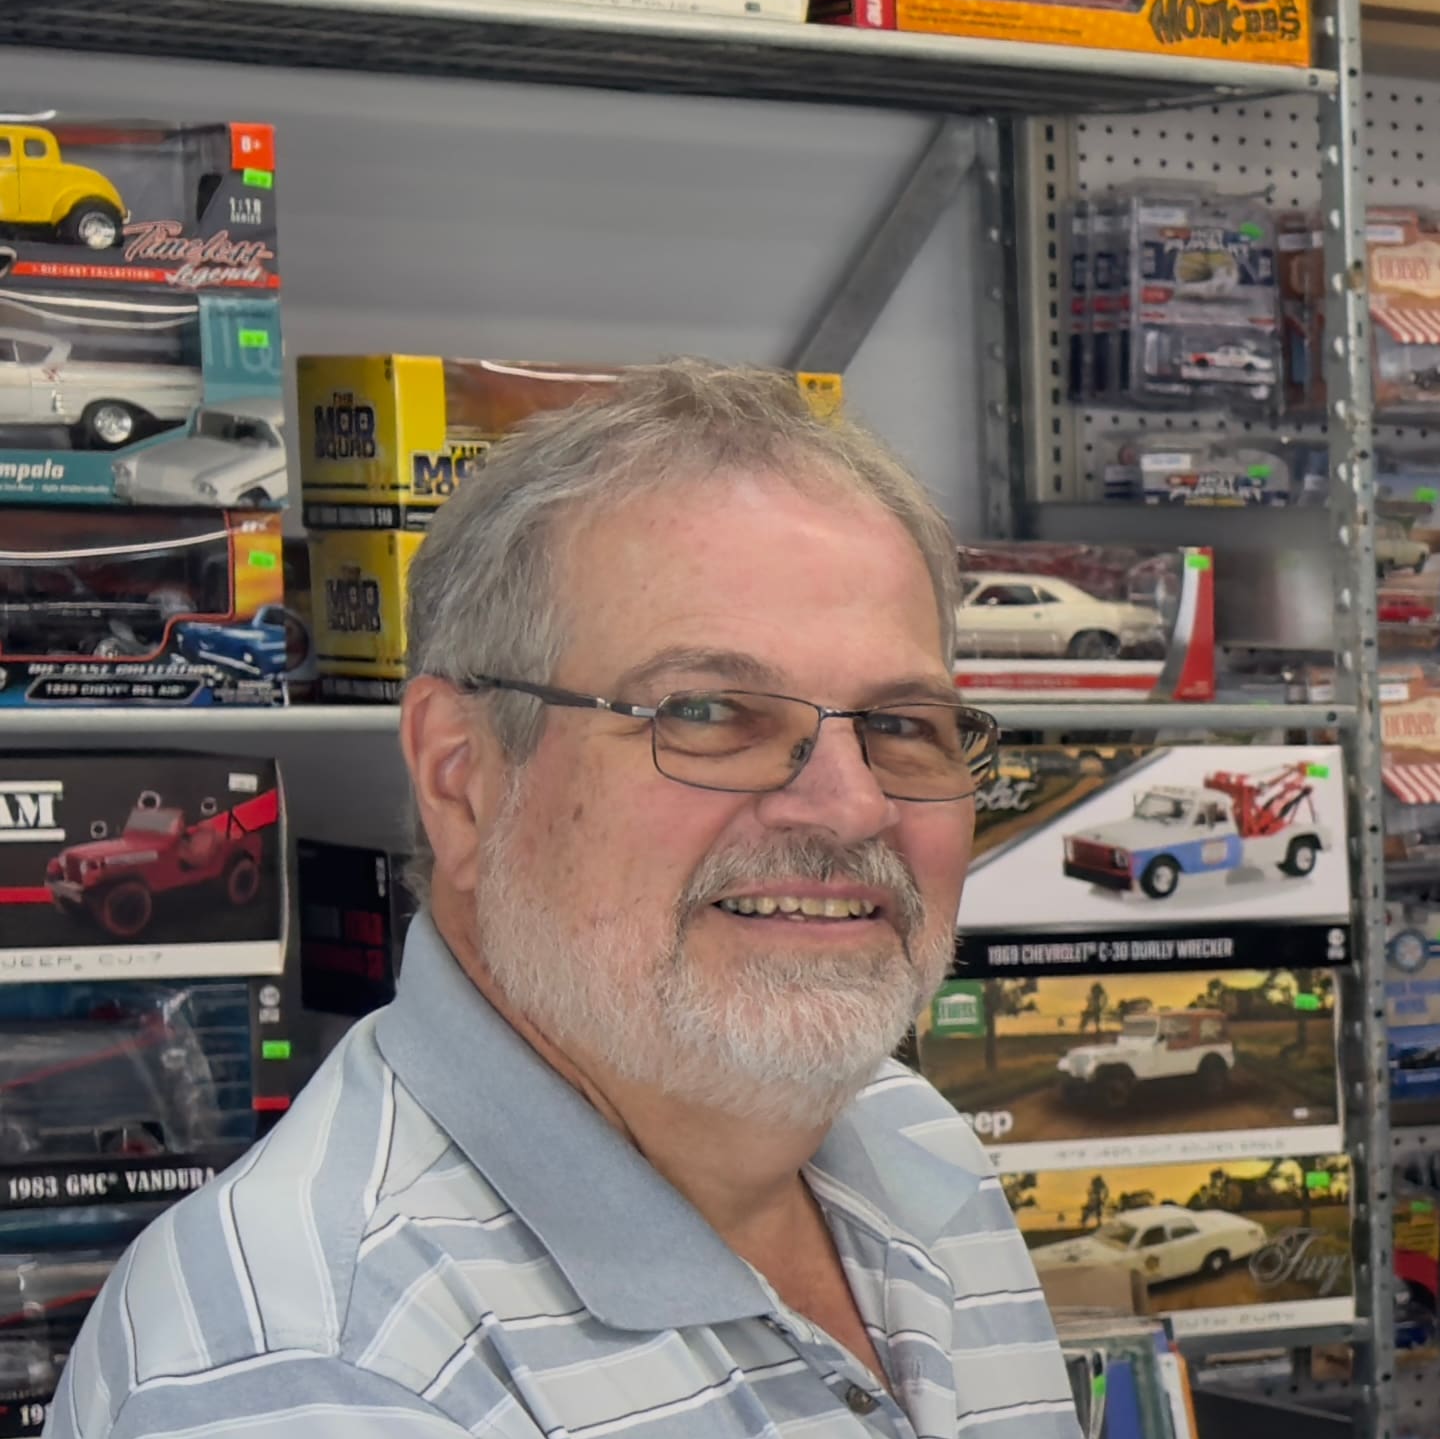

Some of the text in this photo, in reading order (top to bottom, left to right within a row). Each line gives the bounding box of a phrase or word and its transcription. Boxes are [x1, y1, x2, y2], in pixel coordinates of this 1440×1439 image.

[123, 220, 274, 266] Timeless
[167, 264, 262, 290] Legends
[314, 406, 375, 435] MOD
[0, 457, 64, 482] mpala
[0, 793, 55, 828] AM
[1176, 937, 1233, 959] WRECKER
[965, 1111, 1014, 1138] eep
[8, 1175, 58, 1200] 1983
[126, 1168, 217, 1194] VANDURA
